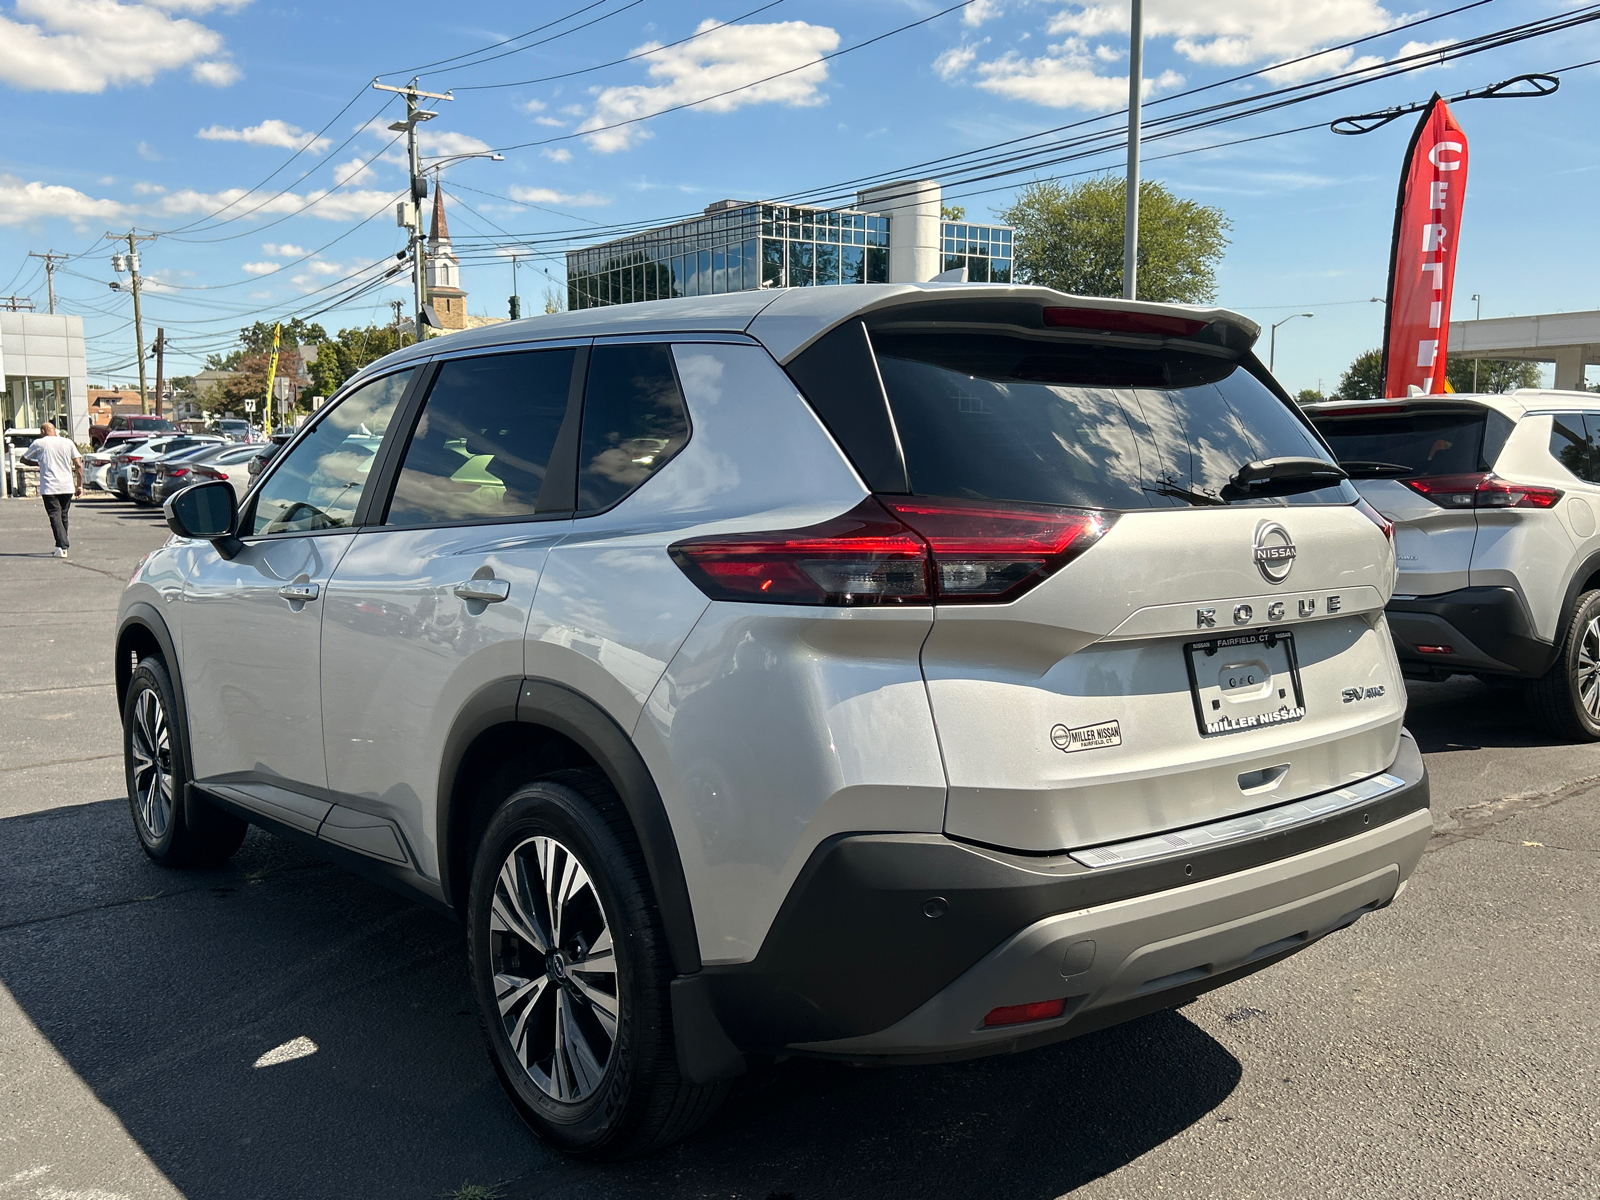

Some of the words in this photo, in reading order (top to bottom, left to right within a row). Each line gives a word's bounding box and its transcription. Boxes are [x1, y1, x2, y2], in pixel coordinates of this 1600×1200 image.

[1257, 548, 1296, 559] NISSAN
[1196, 596, 1341, 628] ROGUE
[1217, 637, 1258, 647] FAIRFIELD,
[1258, 634, 1269, 642] CT
[1342, 686, 1364, 704] SV
[1206, 716, 1257, 734] MILLER
[1259, 706, 1305, 724] NISSAN
[1072, 730, 1096, 743] MILLER
[1097, 727, 1119, 739] NISSAN
